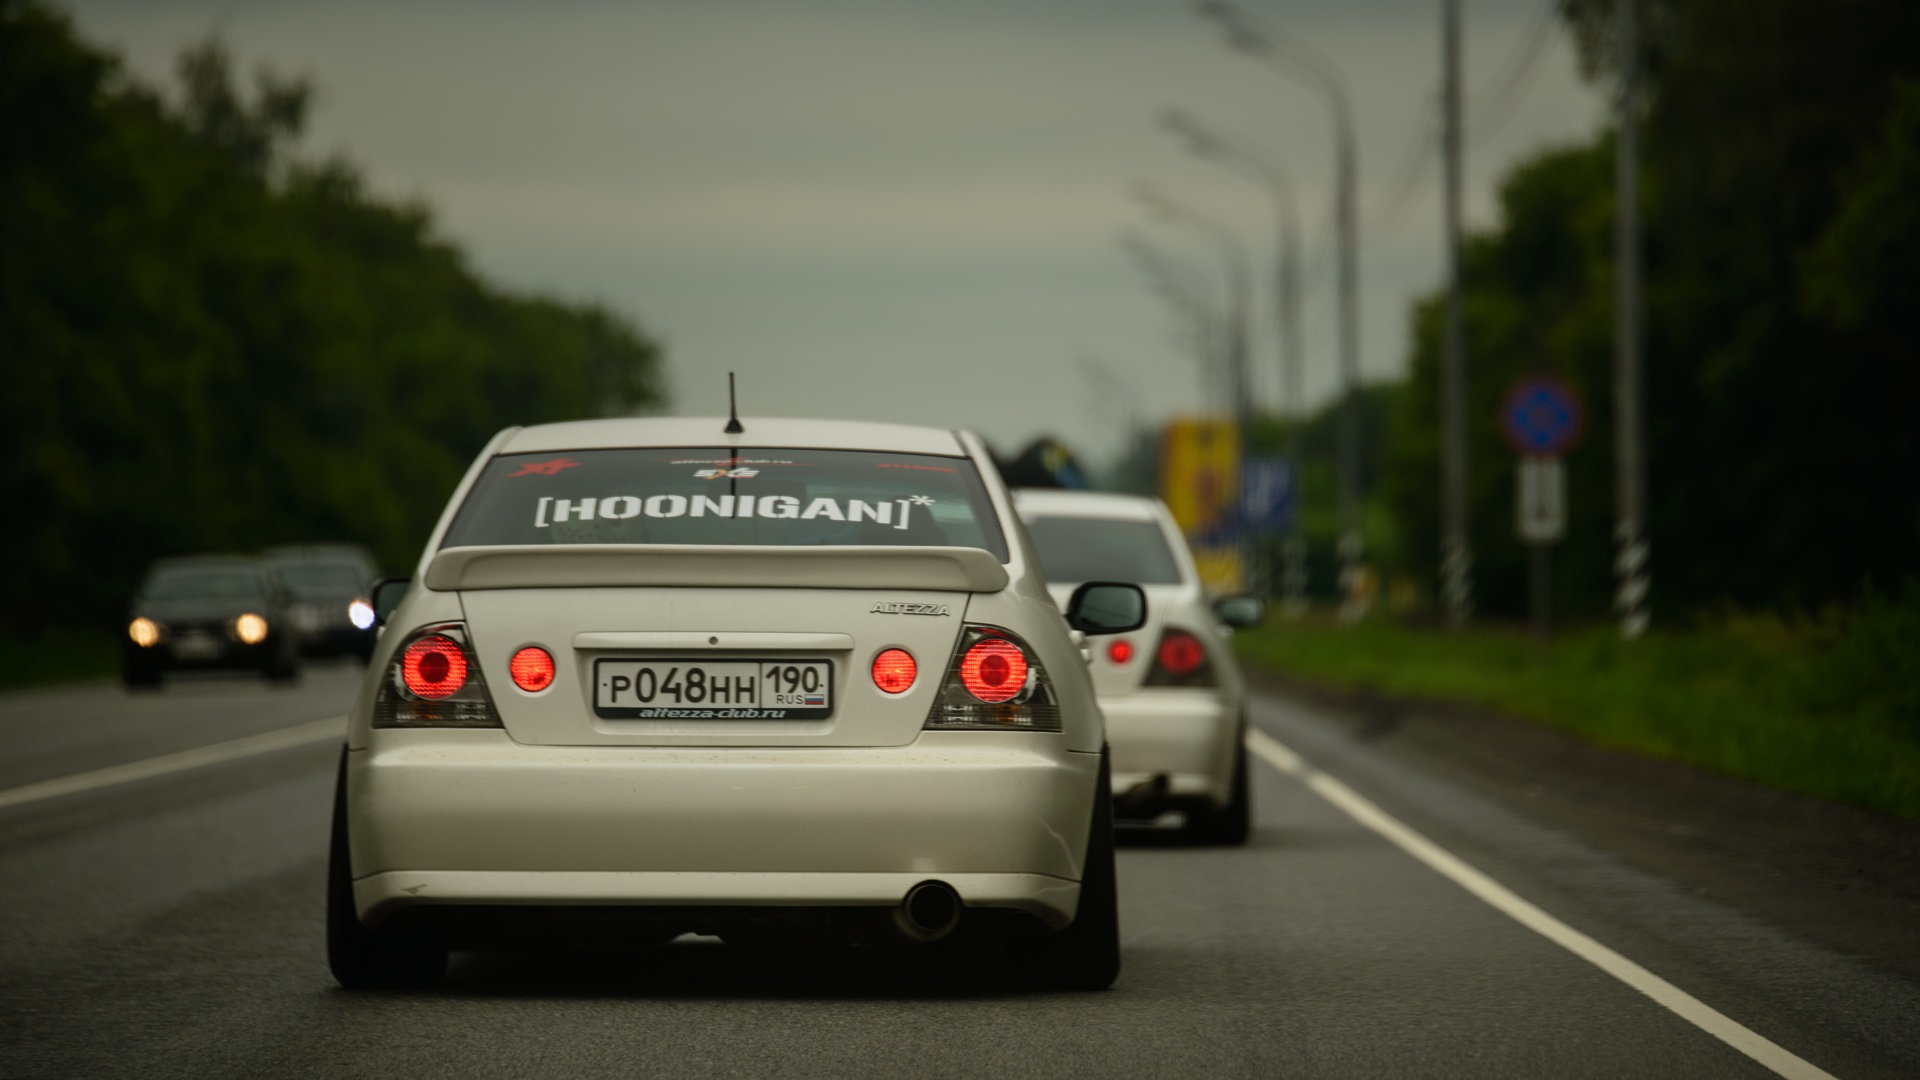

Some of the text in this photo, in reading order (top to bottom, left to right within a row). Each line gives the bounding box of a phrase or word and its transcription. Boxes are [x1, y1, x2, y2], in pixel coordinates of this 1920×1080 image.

[869, 602, 950, 617] ALTEZZA
[765, 665, 819, 693] 190
[776, 694, 803, 705] RUS
[639, 708, 786, 718] altezza-club.ru
